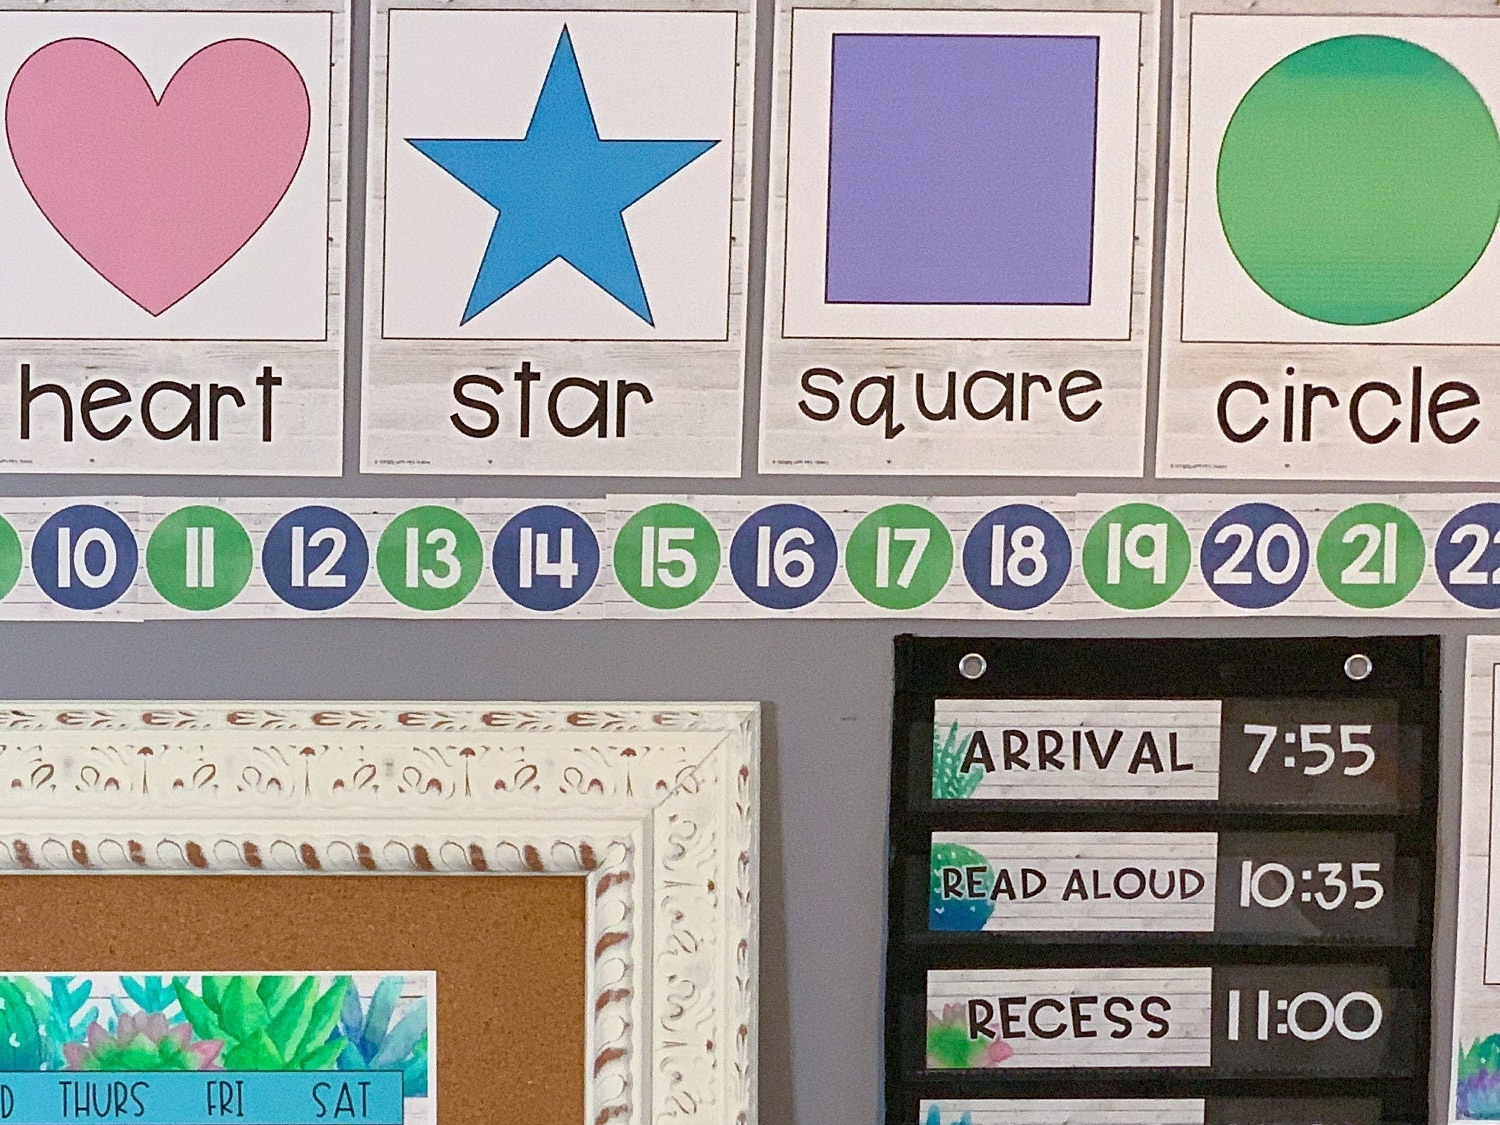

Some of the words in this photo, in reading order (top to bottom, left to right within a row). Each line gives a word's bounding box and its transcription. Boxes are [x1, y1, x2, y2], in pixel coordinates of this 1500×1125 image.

[20, 363, 283, 443] heart
[449, 361, 655, 440] star
[798, 366, 1104, 440] square
[1217, 366, 1482, 445] circle
[57, 527, 119, 589] 10
[186, 527, 215, 588] 11
[291, 527, 349, 589] 12
[406, 527, 462, 589] 13
[519, 527, 580, 588] 14
[640, 526, 697, 588] 15
[757, 526, 815, 588] 16
[875, 526, 931, 588] 17
[991, 525, 1049, 587] 18
[1107, 523, 1168, 585] 19
[1211, 523, 1300, 585] 20
[1341, 522, 1398, 584] 21
[959, 729, 1195, 774] ARRIVAL
[1244, 724, 1376, 777] 7:55
[943, 866, 1048, 900] READ
[1062, 867, 1205, 901] ALOUD
[1240, 860, 1385, 910] 10:35
[967, 996, 1173, 1040] RECESS
[1227, 990, 1383, 1042] 11:00
[58, 1081, 151, 1118] THURS
[207, 1080, 245, 1117] FRI
[312, 1081, 372, 1118] SAT
